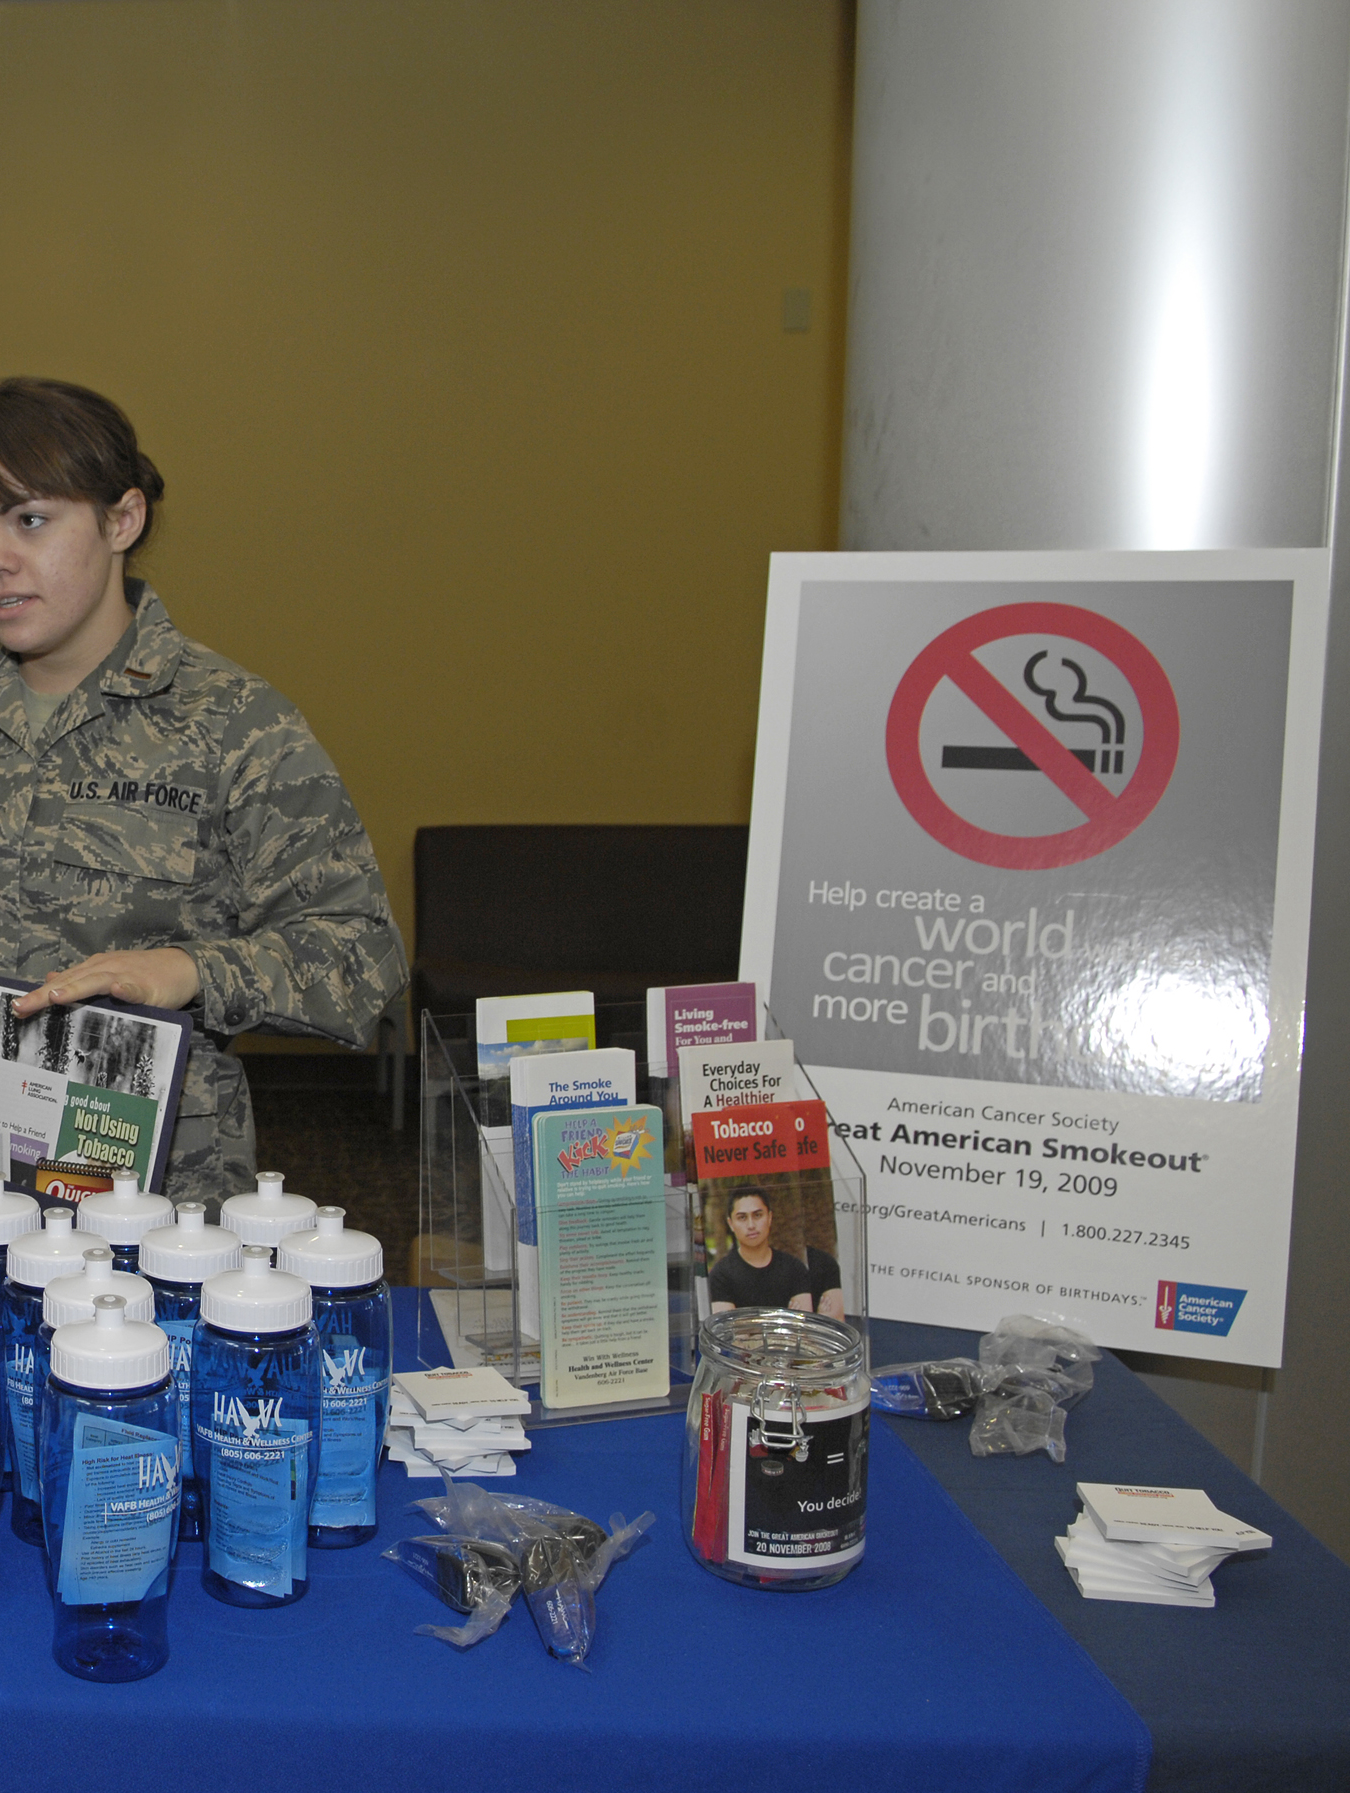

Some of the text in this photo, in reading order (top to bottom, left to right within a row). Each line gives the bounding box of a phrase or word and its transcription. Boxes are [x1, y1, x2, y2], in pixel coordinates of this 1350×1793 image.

[69, 780, 203, 815] U.S. AIR FORCE
[808, 880, 985, 912] Help create a
[915, 907, 1075, 959] world
[823, 951, 1036, 995] cancer and
[674, 1008, 714, 1021] Living
[813, 994, 909, 1024] more
[674, 1019, 749, 1034] Smoke-free
[675, 1033, 733, 1047] For You and
[702, 1060, 761, 1078] Everyday
[28, 1081, 53, 1091] AMERICAN
[549, 1077, 612, 1093] The Smoke
[710, 1074, 782, 1092] Choices For
[70, 1094, 88, 1108] good
[89, 1097, 111, 1112] about
[549, 1090, 619, 1106] Around You
[703, 1091, 776, 1108] A Healthier
[887, 1097, 1119, 1135] American Cancer Society
[1, 1120, 9, 1129] to
[9, 1121, 23, 1135] Help
[28, 1125, 47, 1140] Friend
[74, 1108, 141, 1146] Not Using
[561, 1127, 604, 1143] FRIEND
[711, 1118, 774, 1139] Tobacco
[890, 1123, 1032, 1156] American
[10, 1140, 41, 1162] moking
[77, 1134, 136, 1168] Tobacco
[703, 1139, 787, 1164] Never Safe
[582, 1165, 611, 1177] HABIT
[880, 1154, 1118, 1197] November 19, 2009
[1062, 1223, 1191, 1250] 1.800.227.2345
[870, 1263, 895, 1277] THE
[900, 1267, 961, 1285] OFFICIAL
[967, 1275, 1030, 1293] SPONSOR
[1036, 1284, 1053, 1295] OF
[1178, 1294, 1234, 1309] American
[1178, 1303, 1218, 1316] Cancer
[611, 1351, 639, 1359] Wellness
[568, 1357, 654, 1373] Health and Wellness Center
[574, 1370, 608, 1380] Vandenberg
[608, 1369, 618, 1377] Air
[618, 1368, 634, 1376] Force
[597, 1376, 625, 1386] 606-2221
[330, 1397, 368, 1408] 606-2221
[196, 1423, 213, 1439] VAFB
[242, 1436, 250, 1446] &
[220, 1447, 286, 1461] (805) 606-2221
[110, 1501, 138, 1512] VAFB
[797, 1500, 824, 1513] You
[747, 1529, 760, 1538] JOIN
[760, 1531, 770, 1540] THE
[771, 1532, 789, 1541] GREAT
[790, 1531, 815, 1541] AMERICAN
[756, 1541, 767, 1553] 20
[769, 1543, 813, 1555] NOVEMBER
